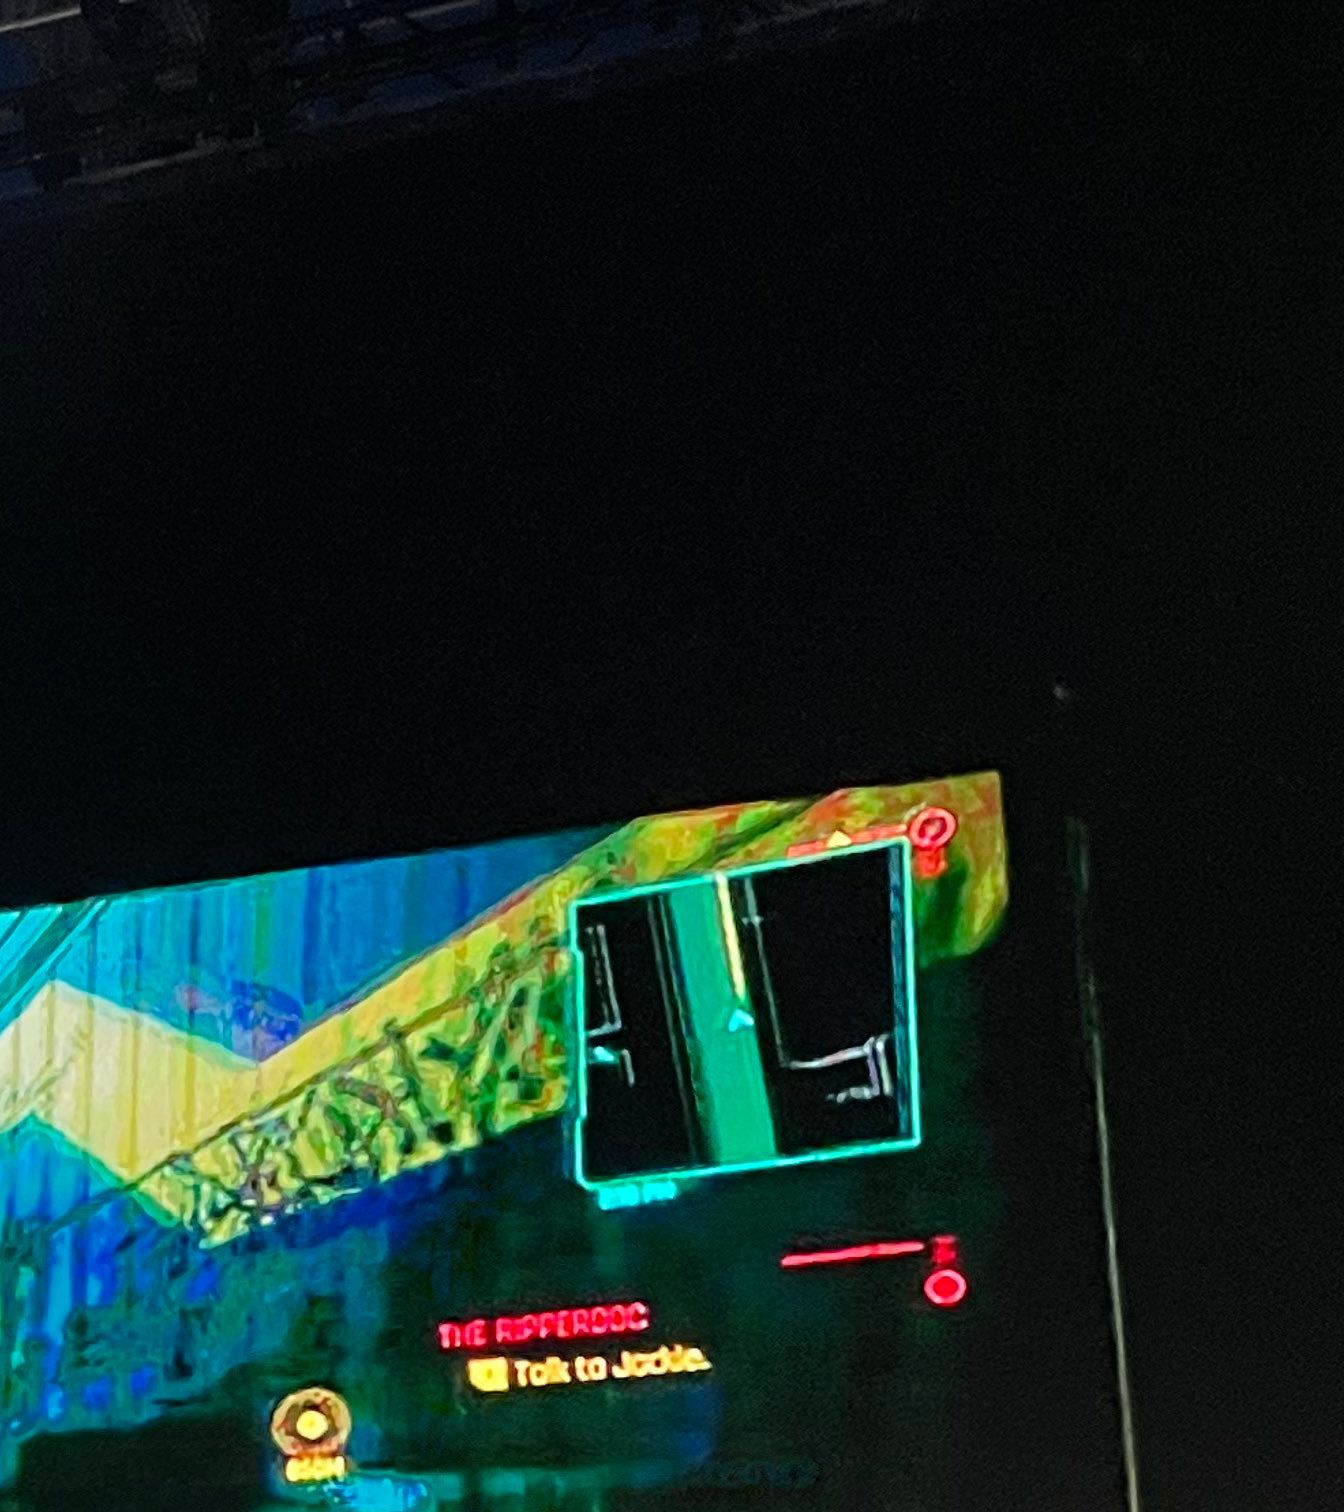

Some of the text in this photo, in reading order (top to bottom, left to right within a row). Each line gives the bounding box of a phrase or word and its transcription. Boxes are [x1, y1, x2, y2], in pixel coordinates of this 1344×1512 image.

[438, 1319, 488, 1349] THE
[513, 1355, 571, 1388] Talk
[574, 1355, 607, 1383] to
